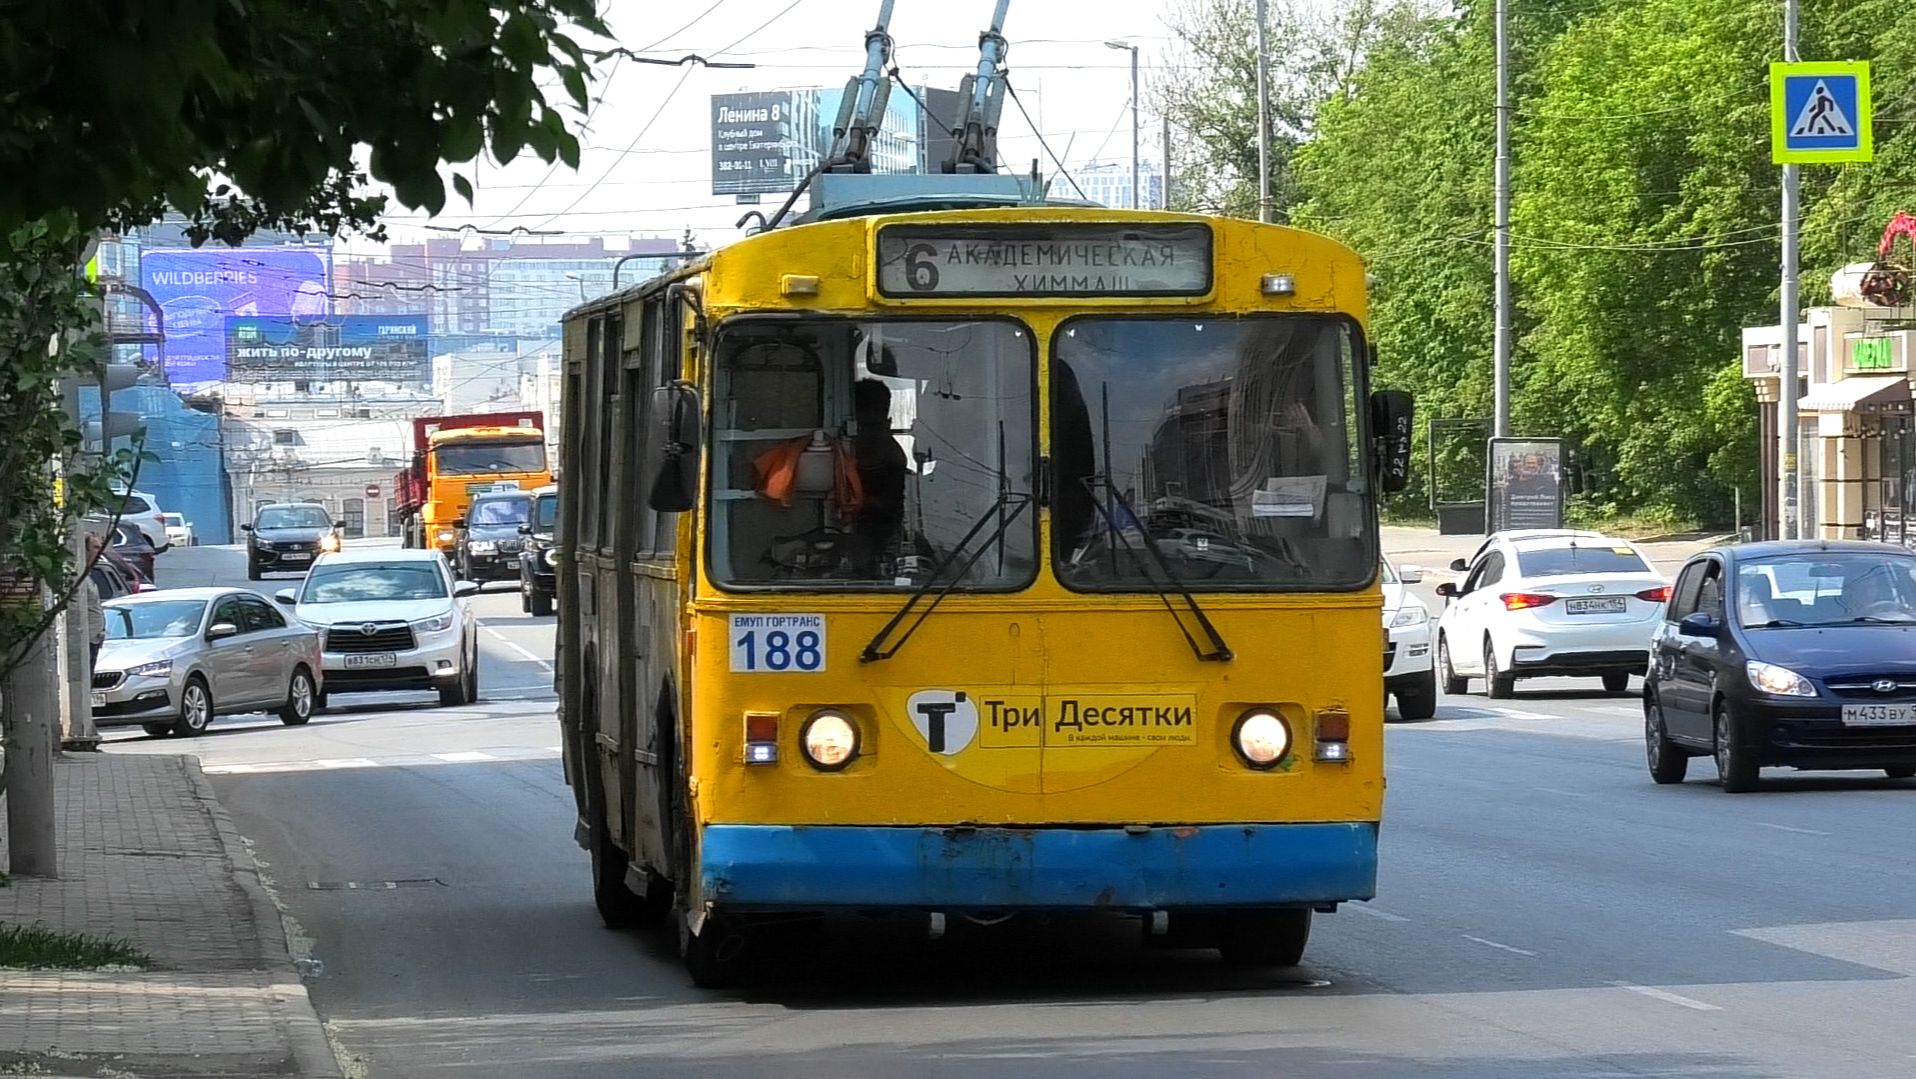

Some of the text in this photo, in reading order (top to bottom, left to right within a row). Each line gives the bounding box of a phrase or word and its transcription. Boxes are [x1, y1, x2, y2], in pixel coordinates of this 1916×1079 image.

[718, 104, 780, 123] Ленина 8
[718, 129, 763, 140] Клубный дом
[724, 142, 748, 152] центре
[905, 243, 1175, 291] 6 АКАДЕМИЧЕСКАЯ
[152, 271, 257, 286] WILDBERRIES
[1013, 274, 1129, 291] ХИММАШ
[237, 346, 373, 360] жить по-другому
[734, 616, 820, 627] ЕМУП ГОРТРАНС
[737, 630, 822, 670] 188
[984, 700, 1041, 732] Три
[1055, 700, 1193, 732] Десятки
[1076, 733, 1106, 743] каждой
